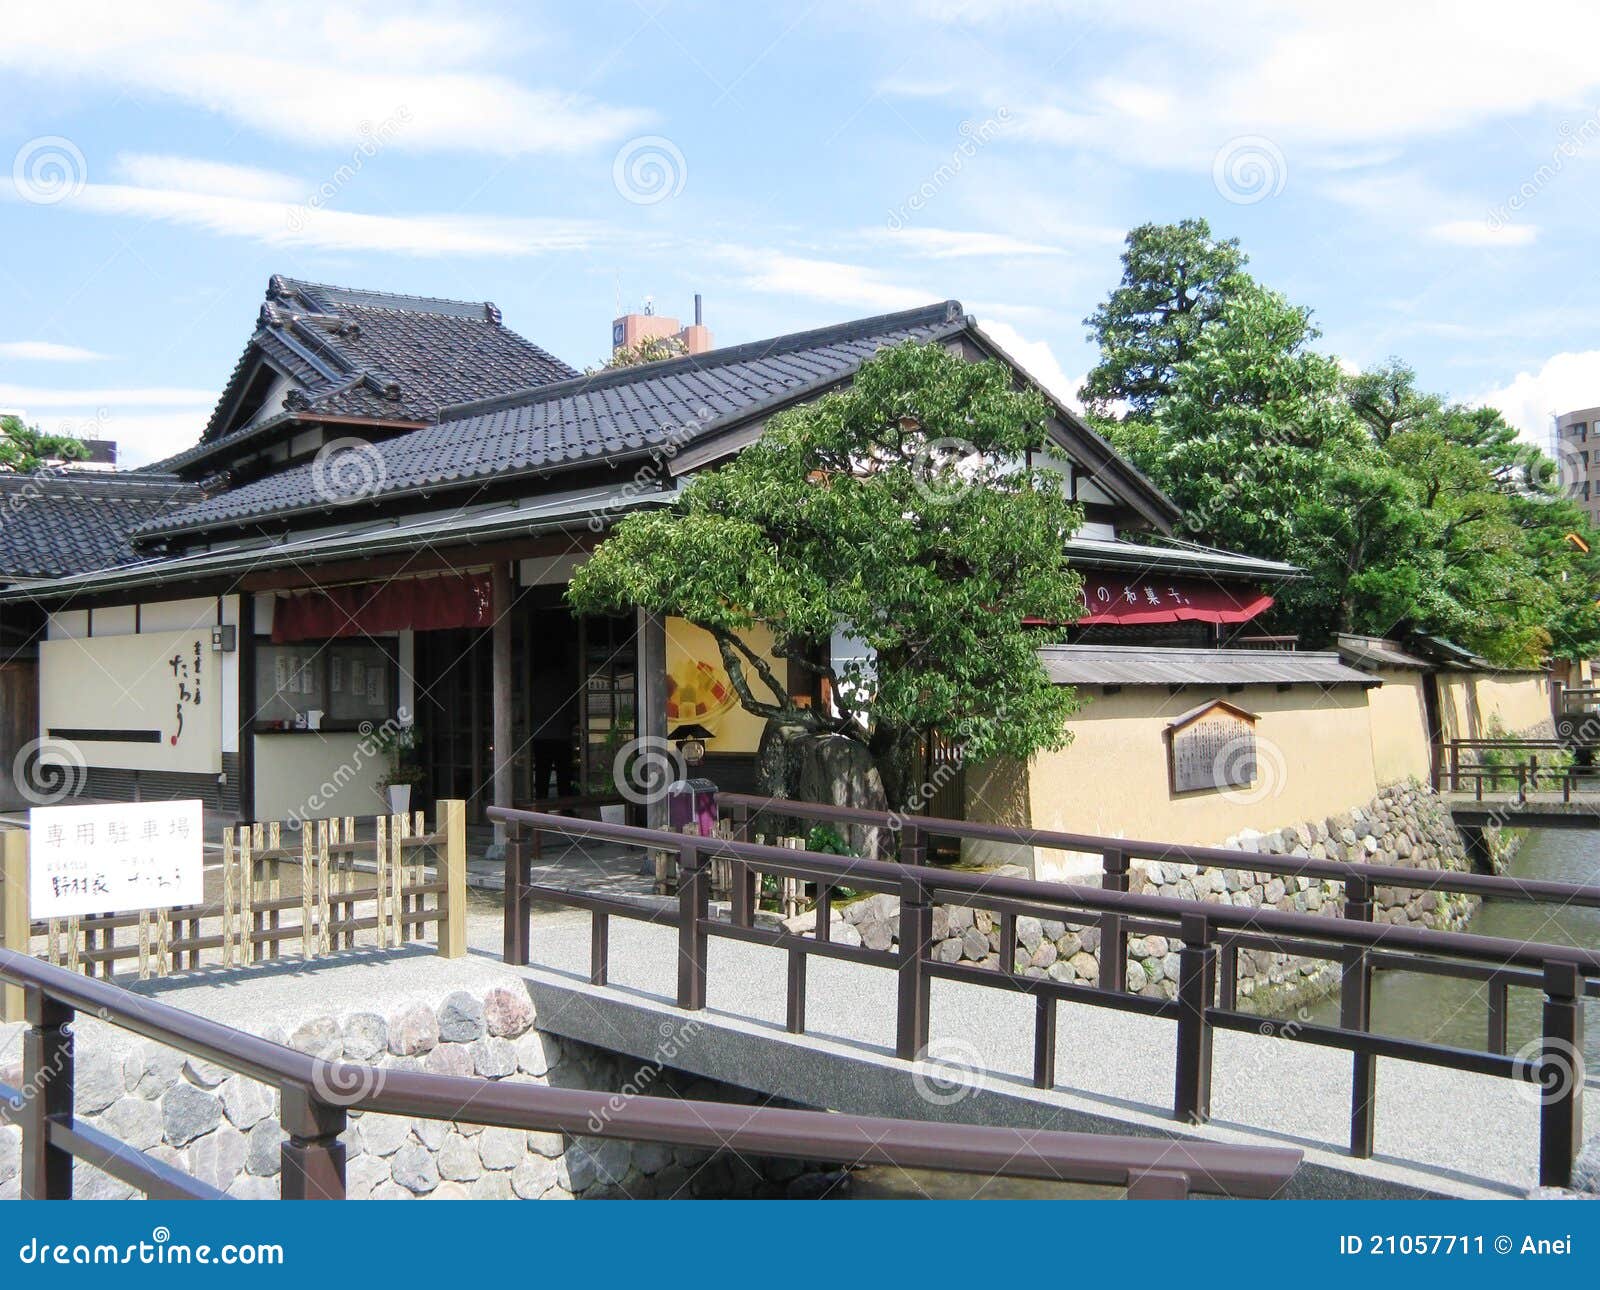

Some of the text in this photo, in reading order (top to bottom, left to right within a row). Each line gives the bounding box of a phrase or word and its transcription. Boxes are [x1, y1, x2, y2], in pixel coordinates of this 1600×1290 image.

[46, 816, 190, 848] 専用駐車場
